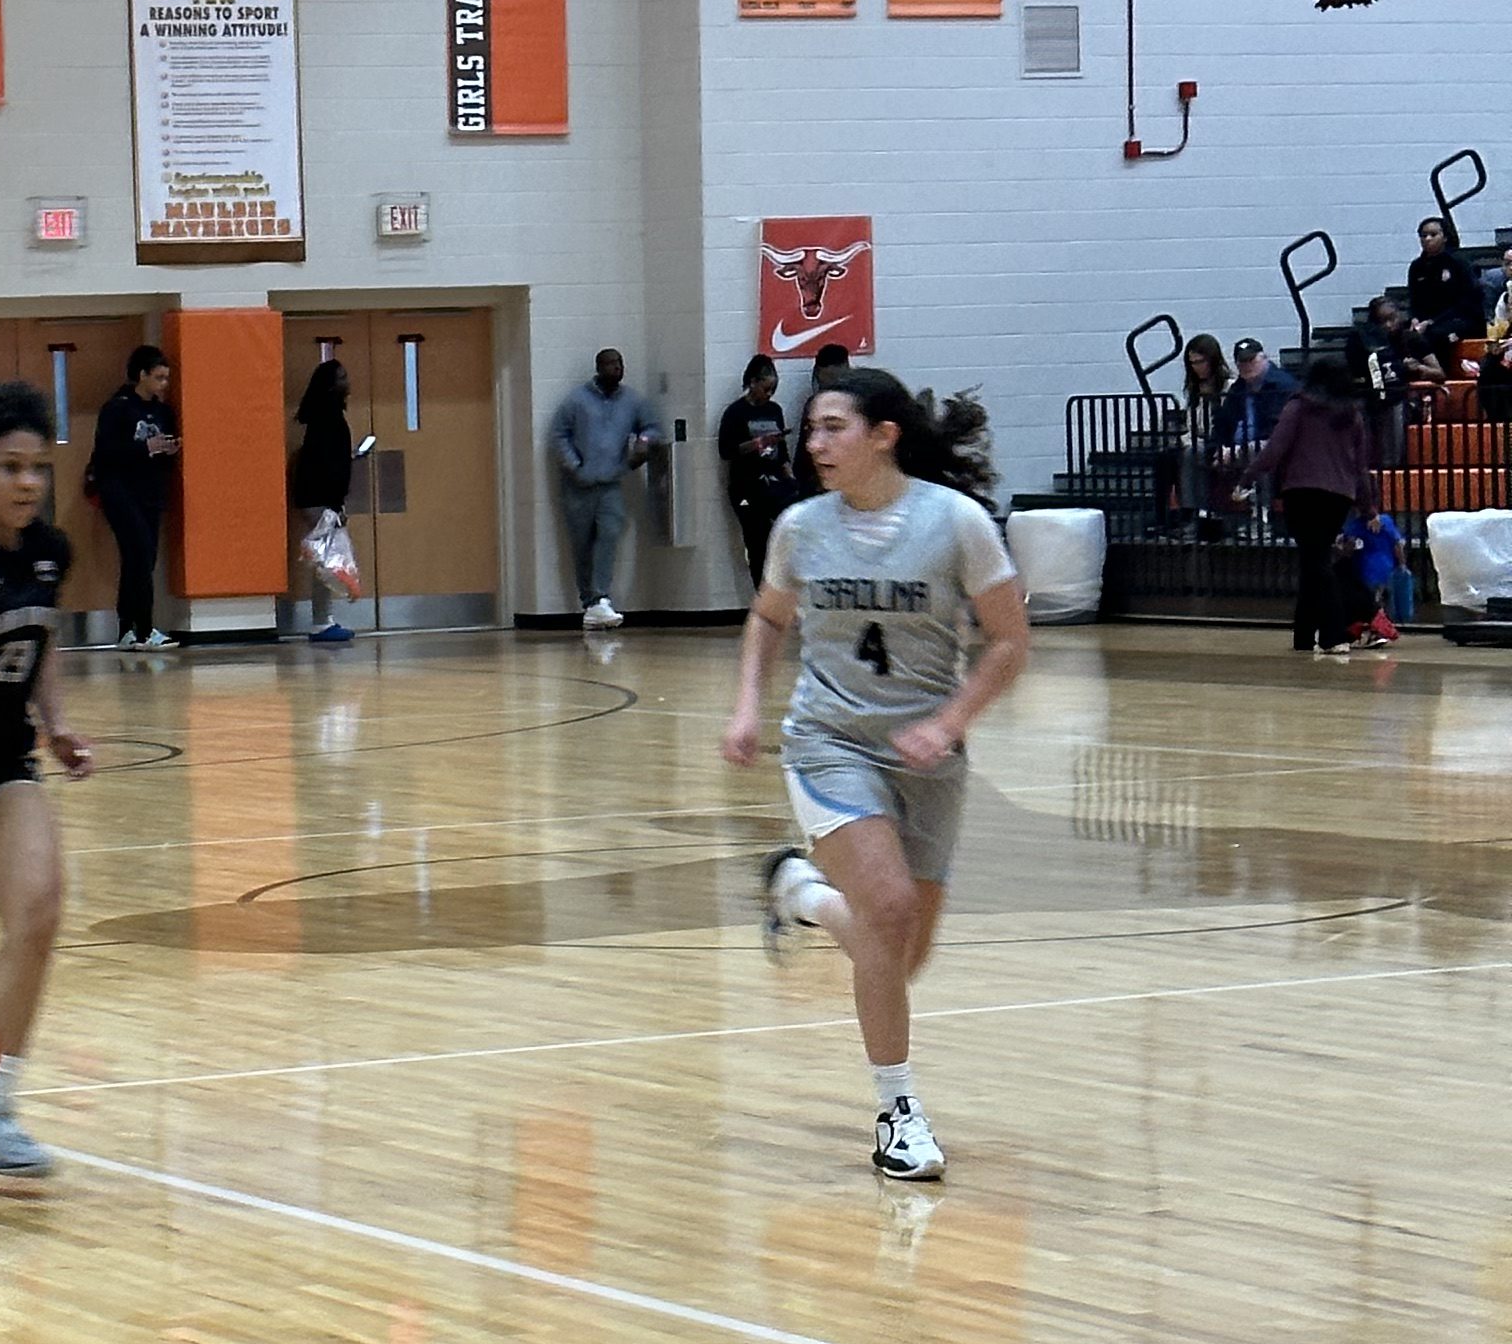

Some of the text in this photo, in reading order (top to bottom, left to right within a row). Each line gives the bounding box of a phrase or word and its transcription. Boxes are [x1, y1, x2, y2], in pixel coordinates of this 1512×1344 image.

[149, 7, 279, 21] REASONS TO SPORT
[140, 23, 288, 37] A WINNING ATTITUDE!
[457, 55, 485, 131] GIRLS
[391, 205, 419, 231] EXIT
